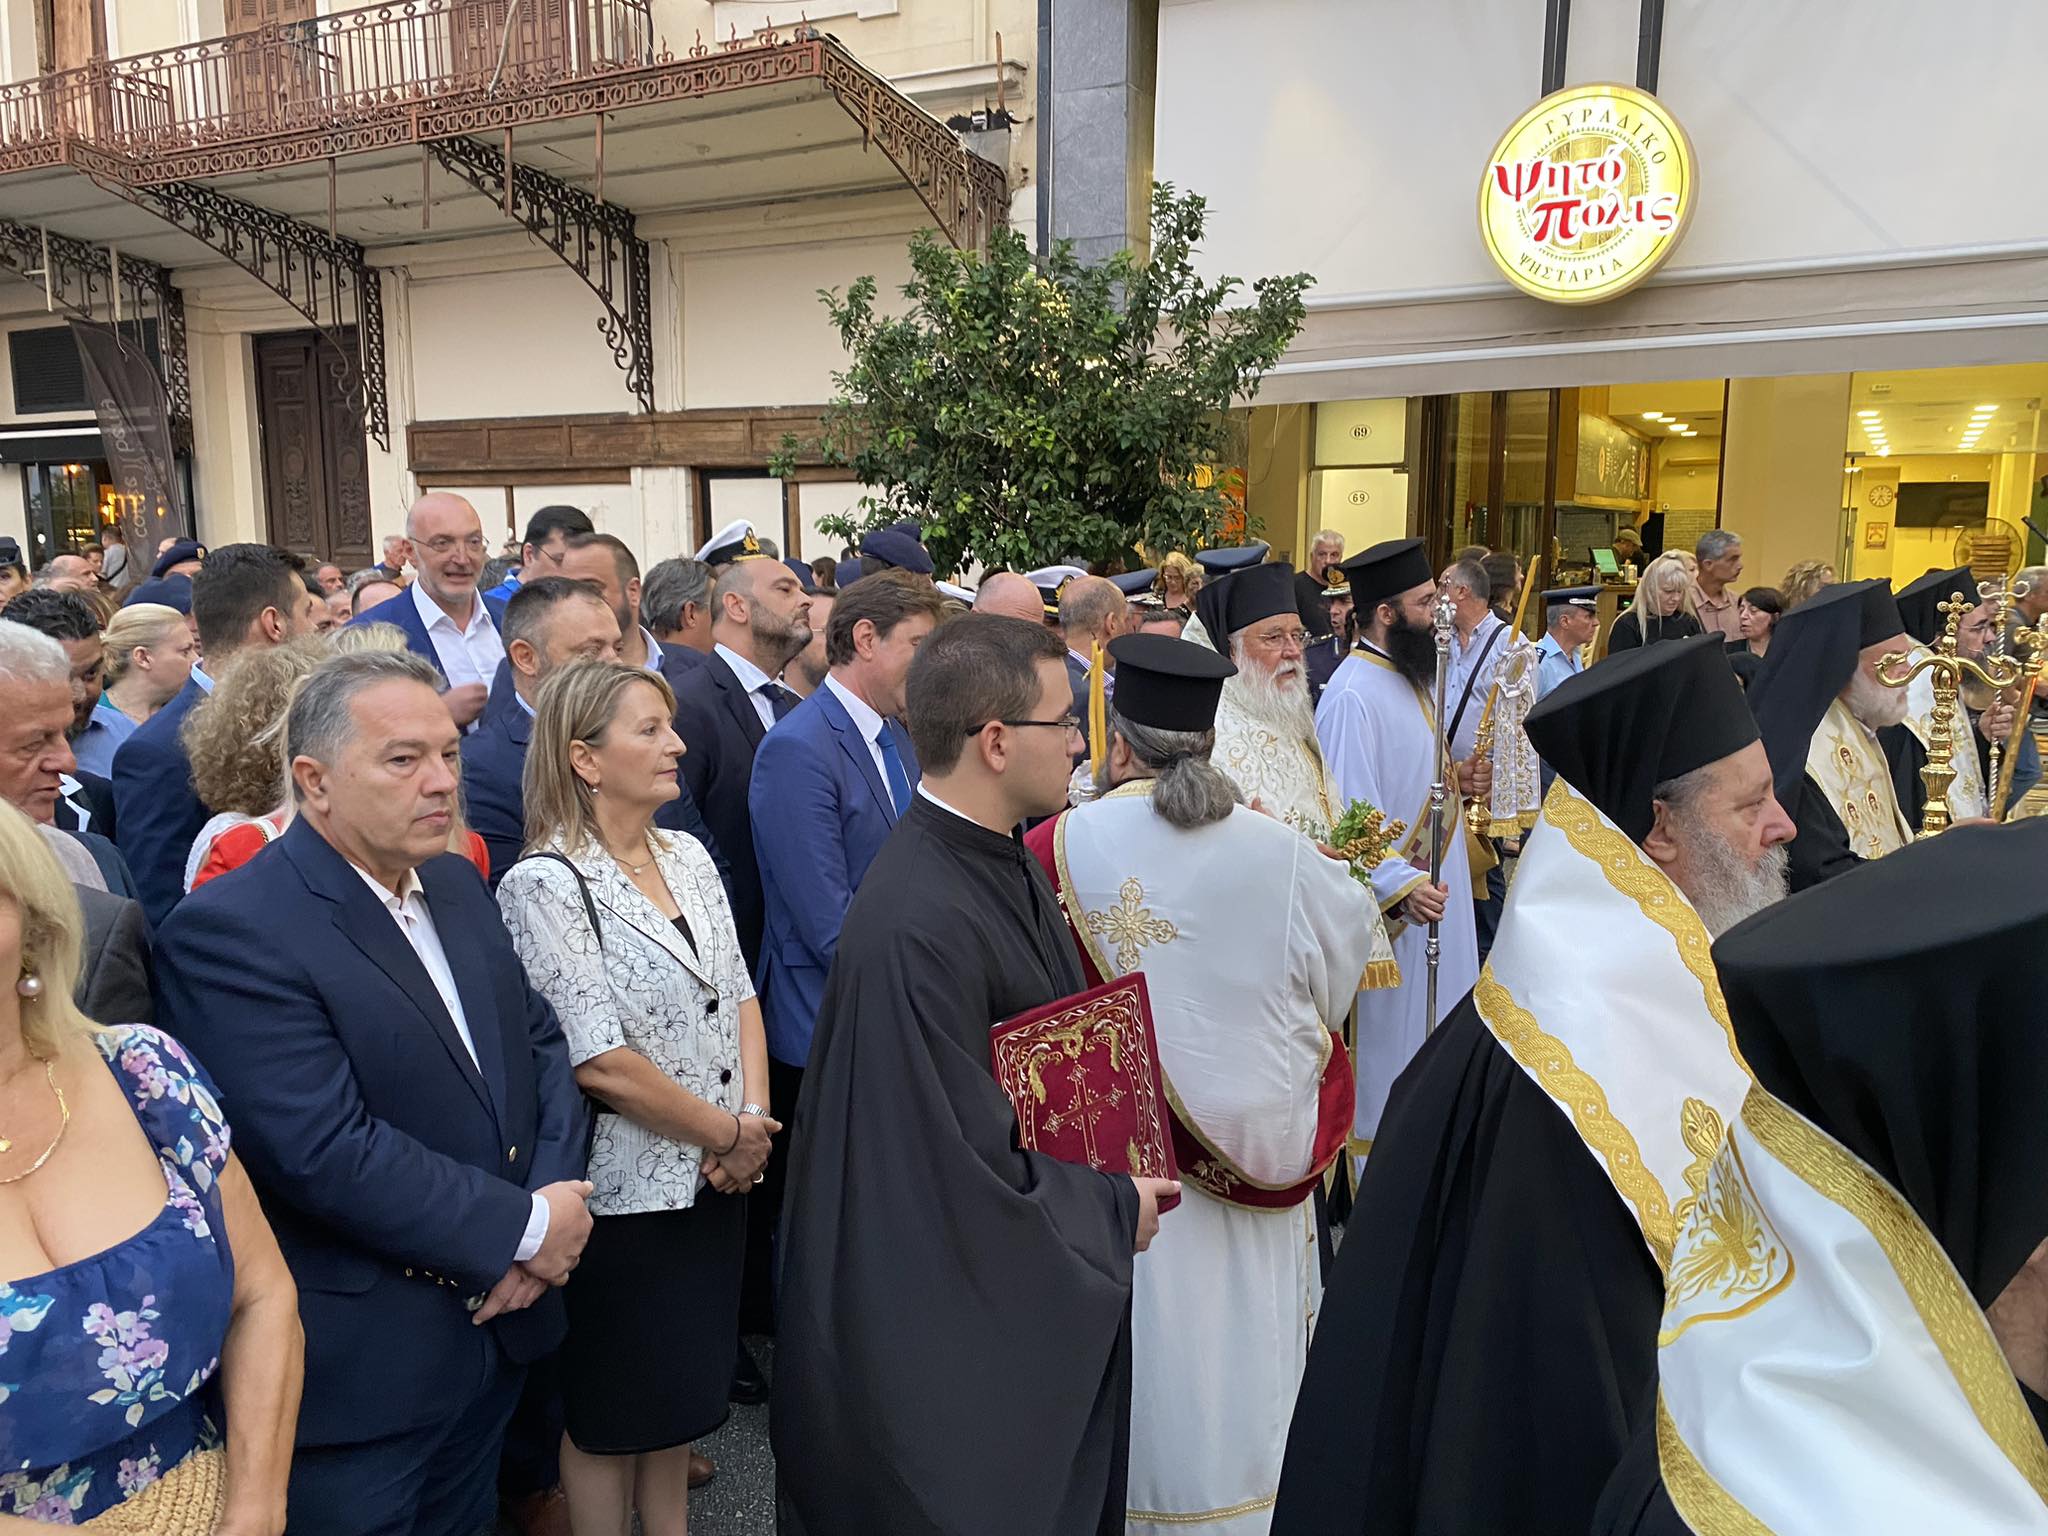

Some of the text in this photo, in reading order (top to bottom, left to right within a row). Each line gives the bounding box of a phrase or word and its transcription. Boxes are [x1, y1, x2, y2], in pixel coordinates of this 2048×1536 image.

[1544, 108, 1667, 165] ΓΥΡΑΔΙΚΟ
[1519, 252, 1623, 283] ΨΗΣΤΑΡΙΑ
[1353, 427, 1368, 437] 69
[1352, 493, 1365, 502] 69
